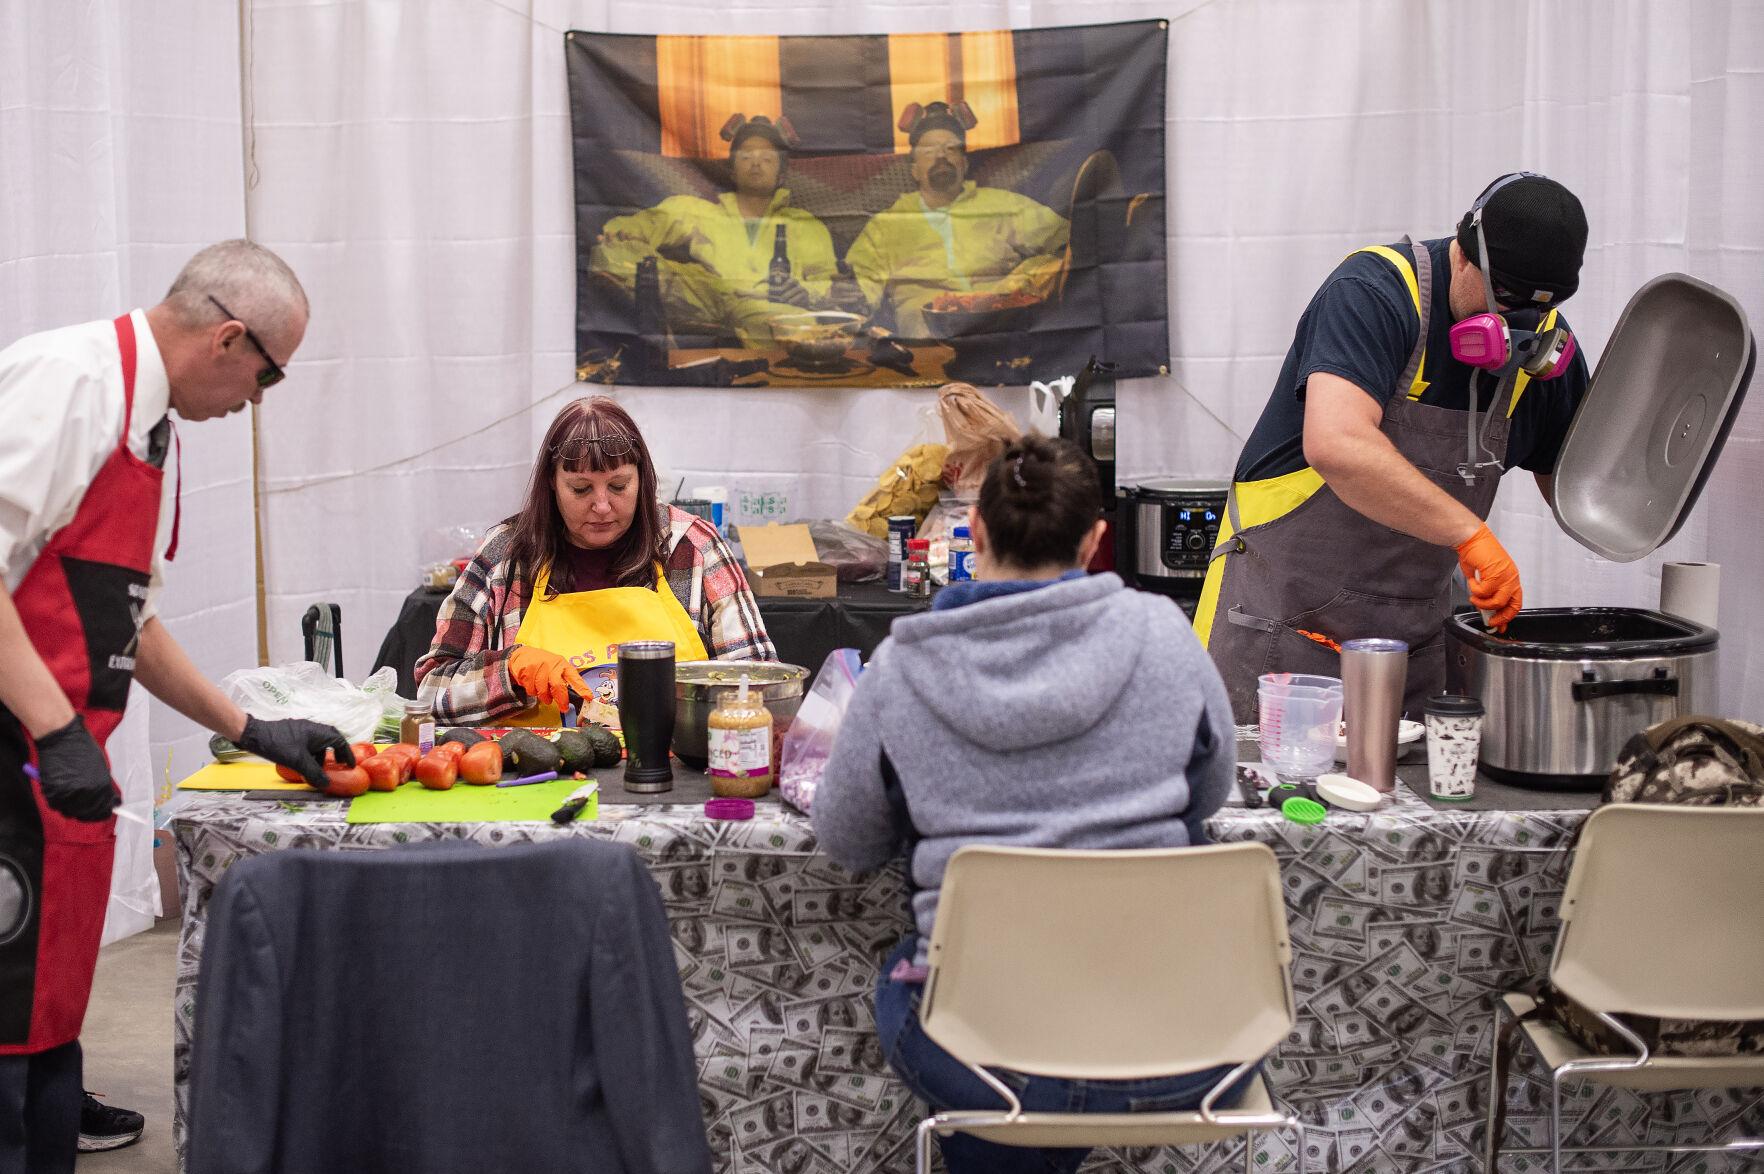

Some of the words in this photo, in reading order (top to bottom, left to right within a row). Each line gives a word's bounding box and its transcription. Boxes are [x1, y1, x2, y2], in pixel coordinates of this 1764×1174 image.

[1180, 511, 1190, 520] HI
[569, 650, 596, 667] OS
[262, 680, 289, 705] OPEN
